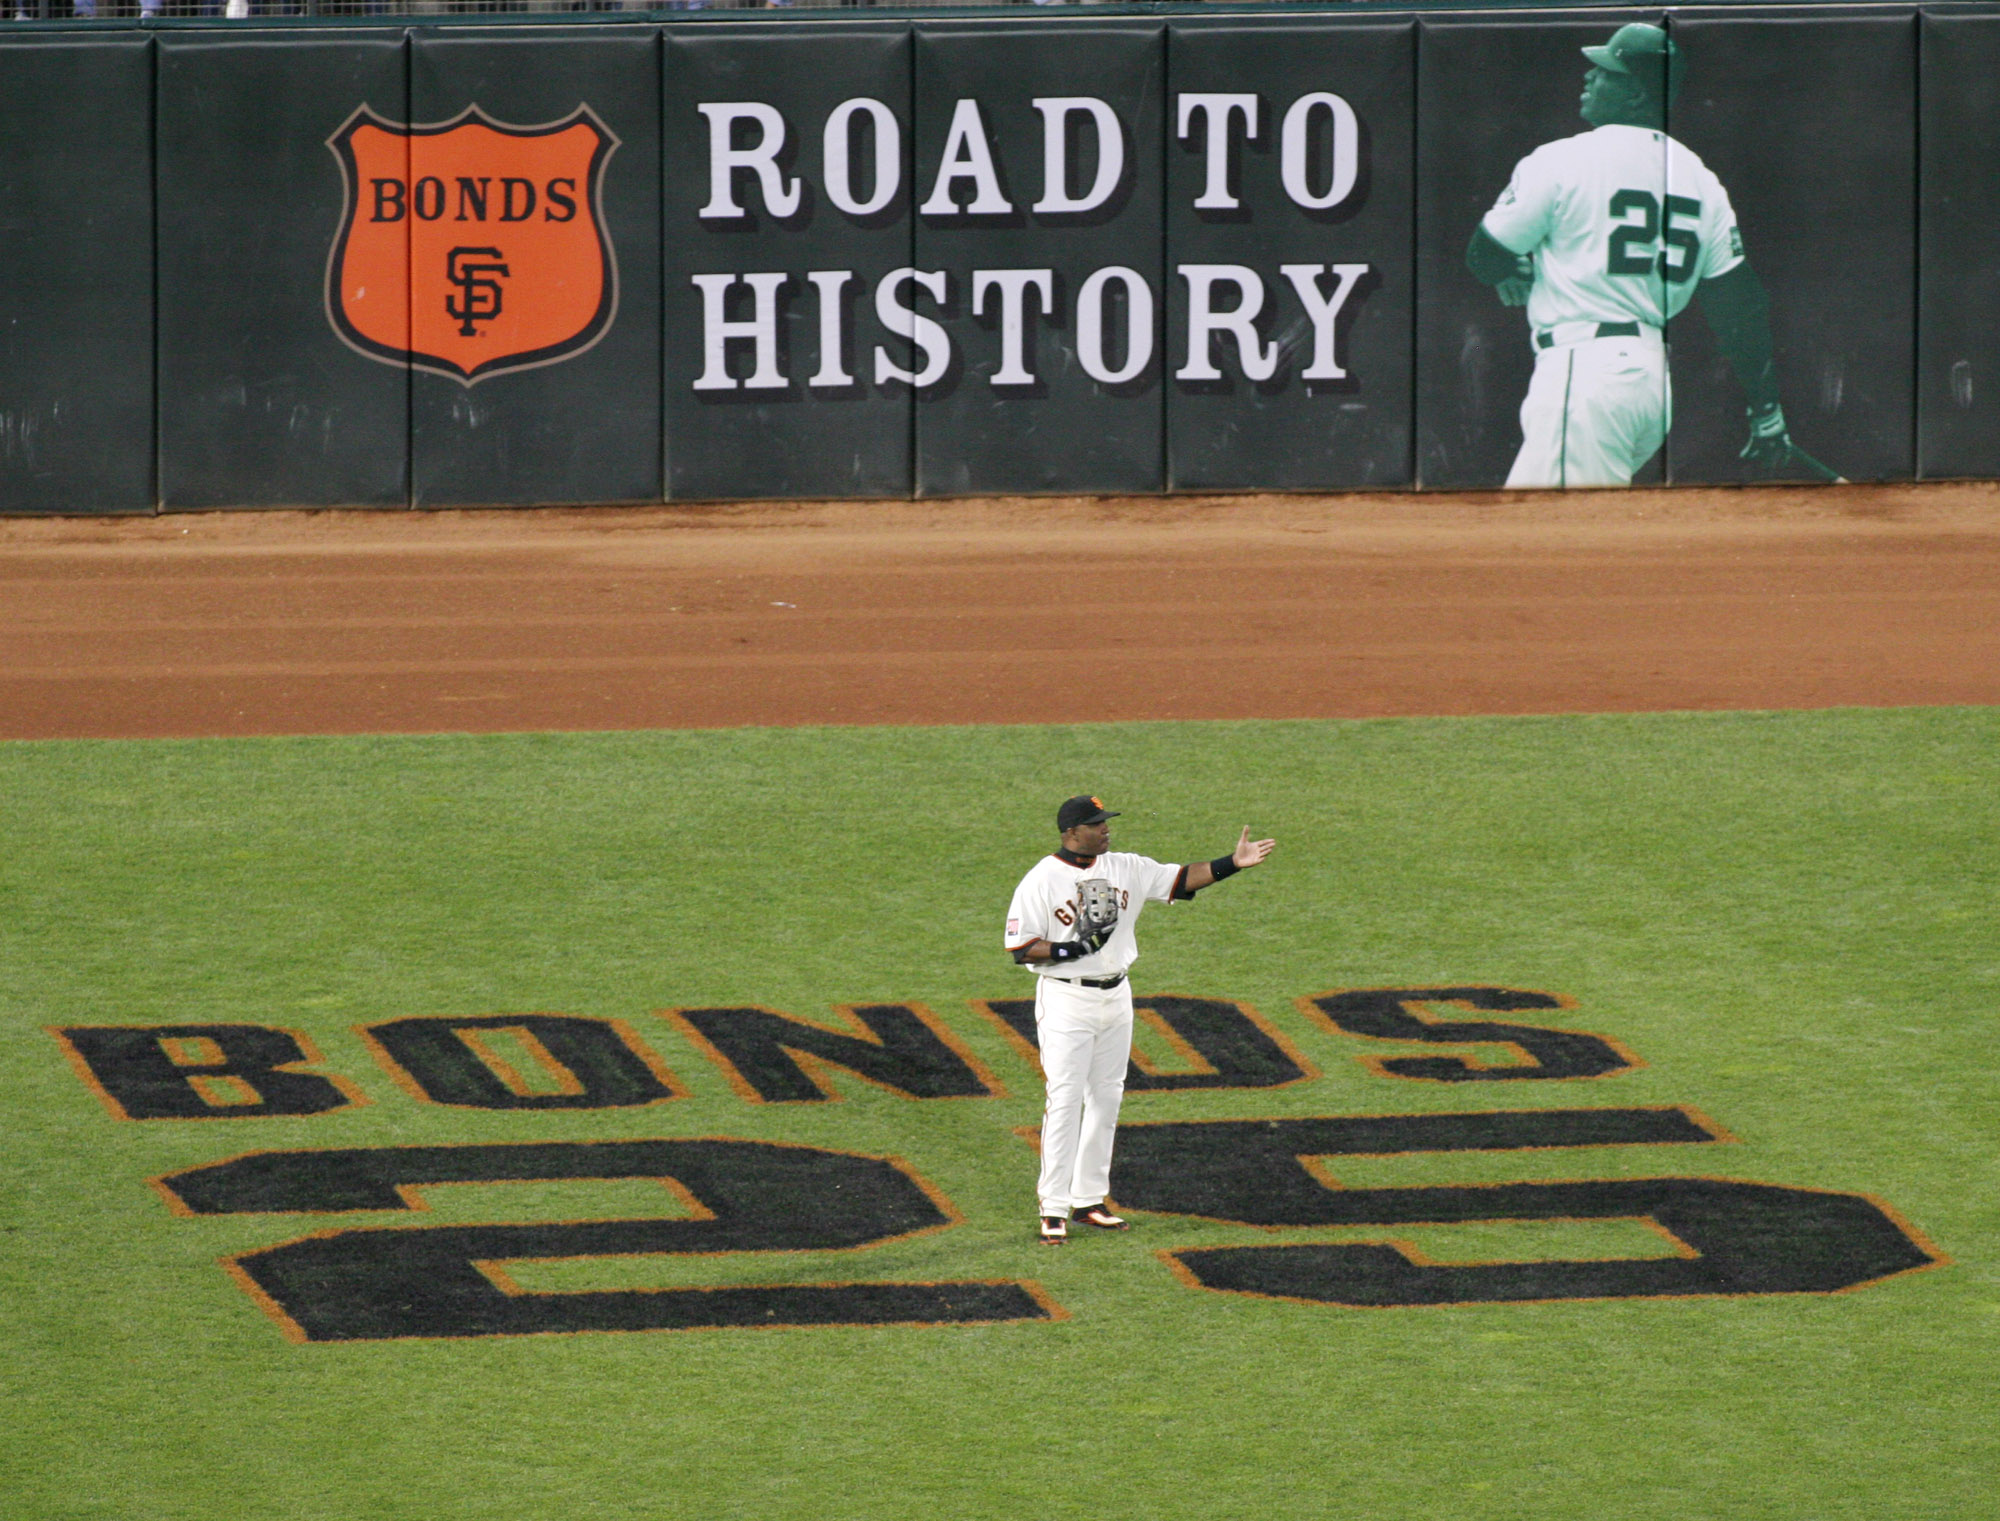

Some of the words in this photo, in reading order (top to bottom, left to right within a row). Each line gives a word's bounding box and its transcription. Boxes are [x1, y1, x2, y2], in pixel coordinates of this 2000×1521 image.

[369, 176, 577, 223] BONDS
[698, 97, 1124, 218] ROAD
[1178, 92, 1358, 209] TO
[1606, 188, 1701, 284] 25
[691, 264, 1369, 390] HISTORY
[46, 983, 1648, 1121] BONDS
[148, 1104, 1953, 1344] 25
